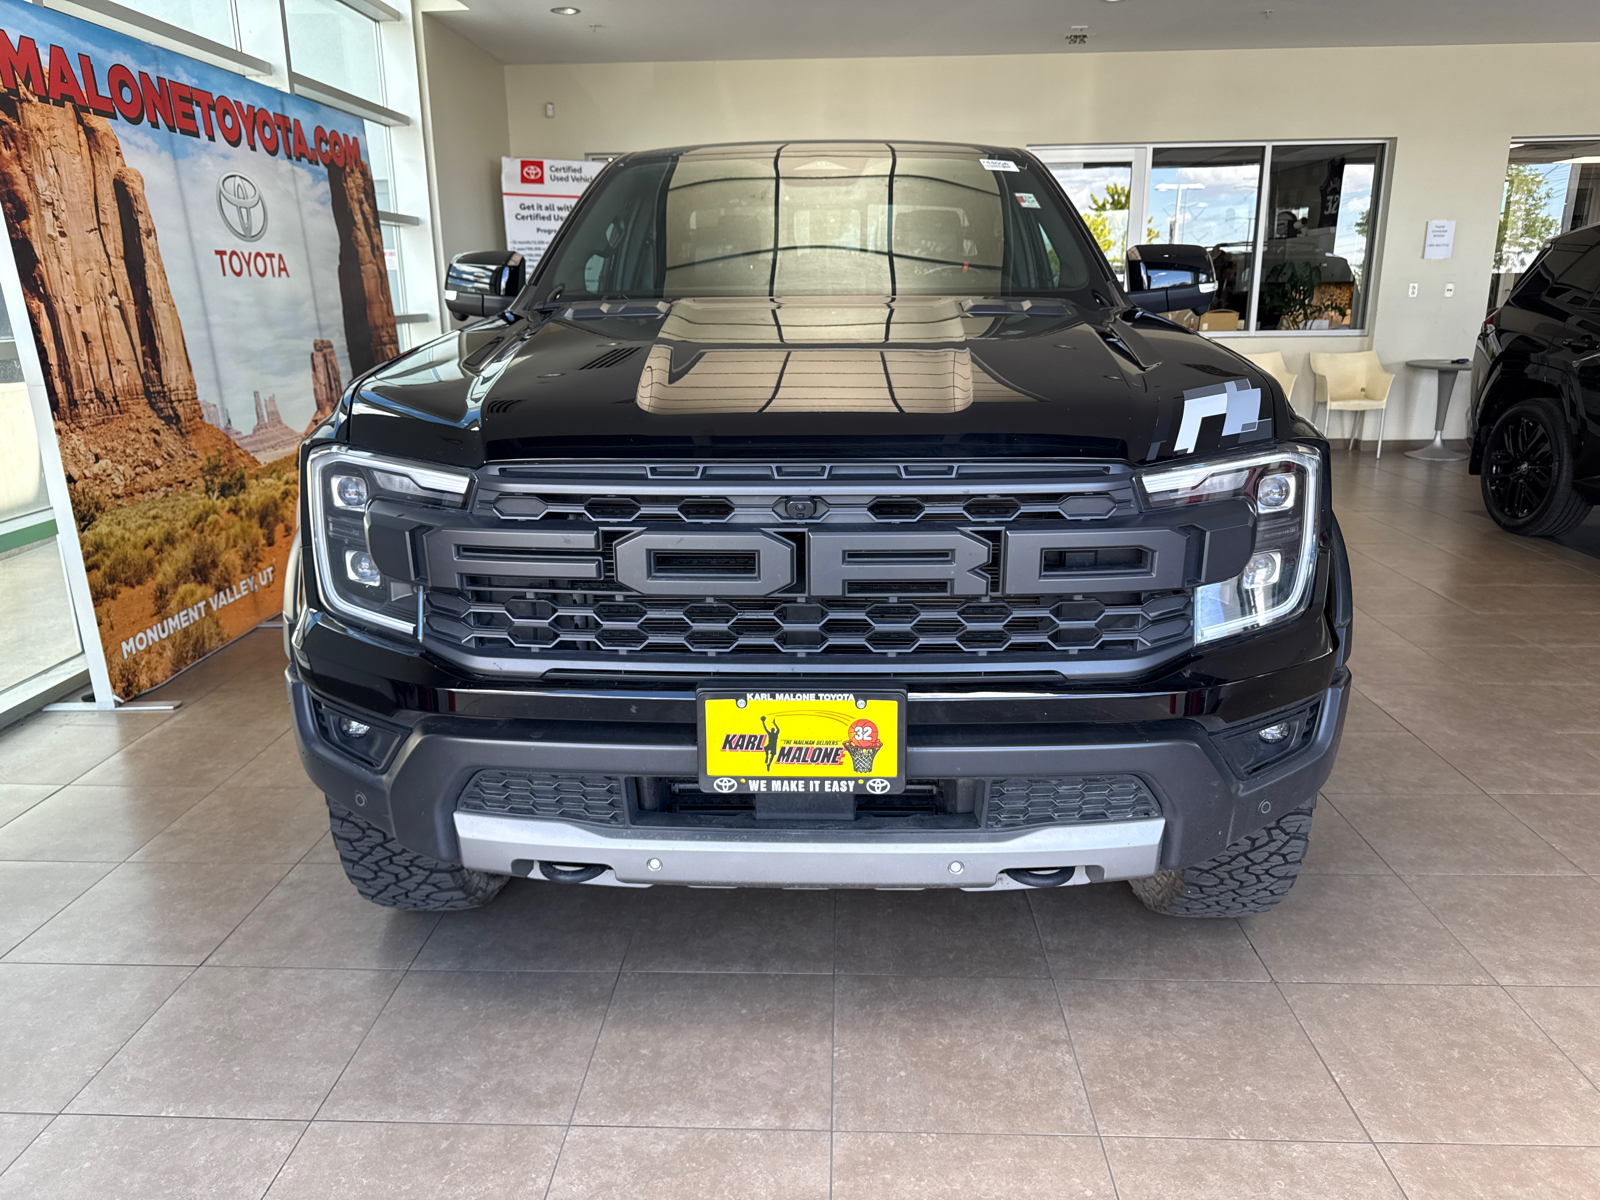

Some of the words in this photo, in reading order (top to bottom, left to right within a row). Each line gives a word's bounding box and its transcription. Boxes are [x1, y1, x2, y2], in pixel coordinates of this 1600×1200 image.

[549, 165, 582, 174] Certified
[550, 174, 569, 182] Used
[519, 203, 534, 211] Get
[536, 203, 543, 211] it
[545, 203, 555, 211] all
[1324, 194, 1340, 215] 32
[515, 213, 552, 221] Certified
[214, 249, 291, 278] TOYOTA
[423, 528, 1190, 597] FORD
[120, 600, 207, 660] MONUMENT
[208, 575, 259, 612] VALLEY,
[258, 566, 275, 587] UT
[746, 693, 774, 701] KARL
[775, 693, 816, 702] MALONE
[818, 693, 855, 702] TOYOTA
[854, 726, 873, 741] 32
[721, 734, 766, 752] KARL
[776, 746, 845, 765] MALONE
[749, 780, 767, 792] WE
[771, 780, 805, 792] MAKE
[809, 780, 820, 792] IT
[824, 780, 855, 792] EASY
